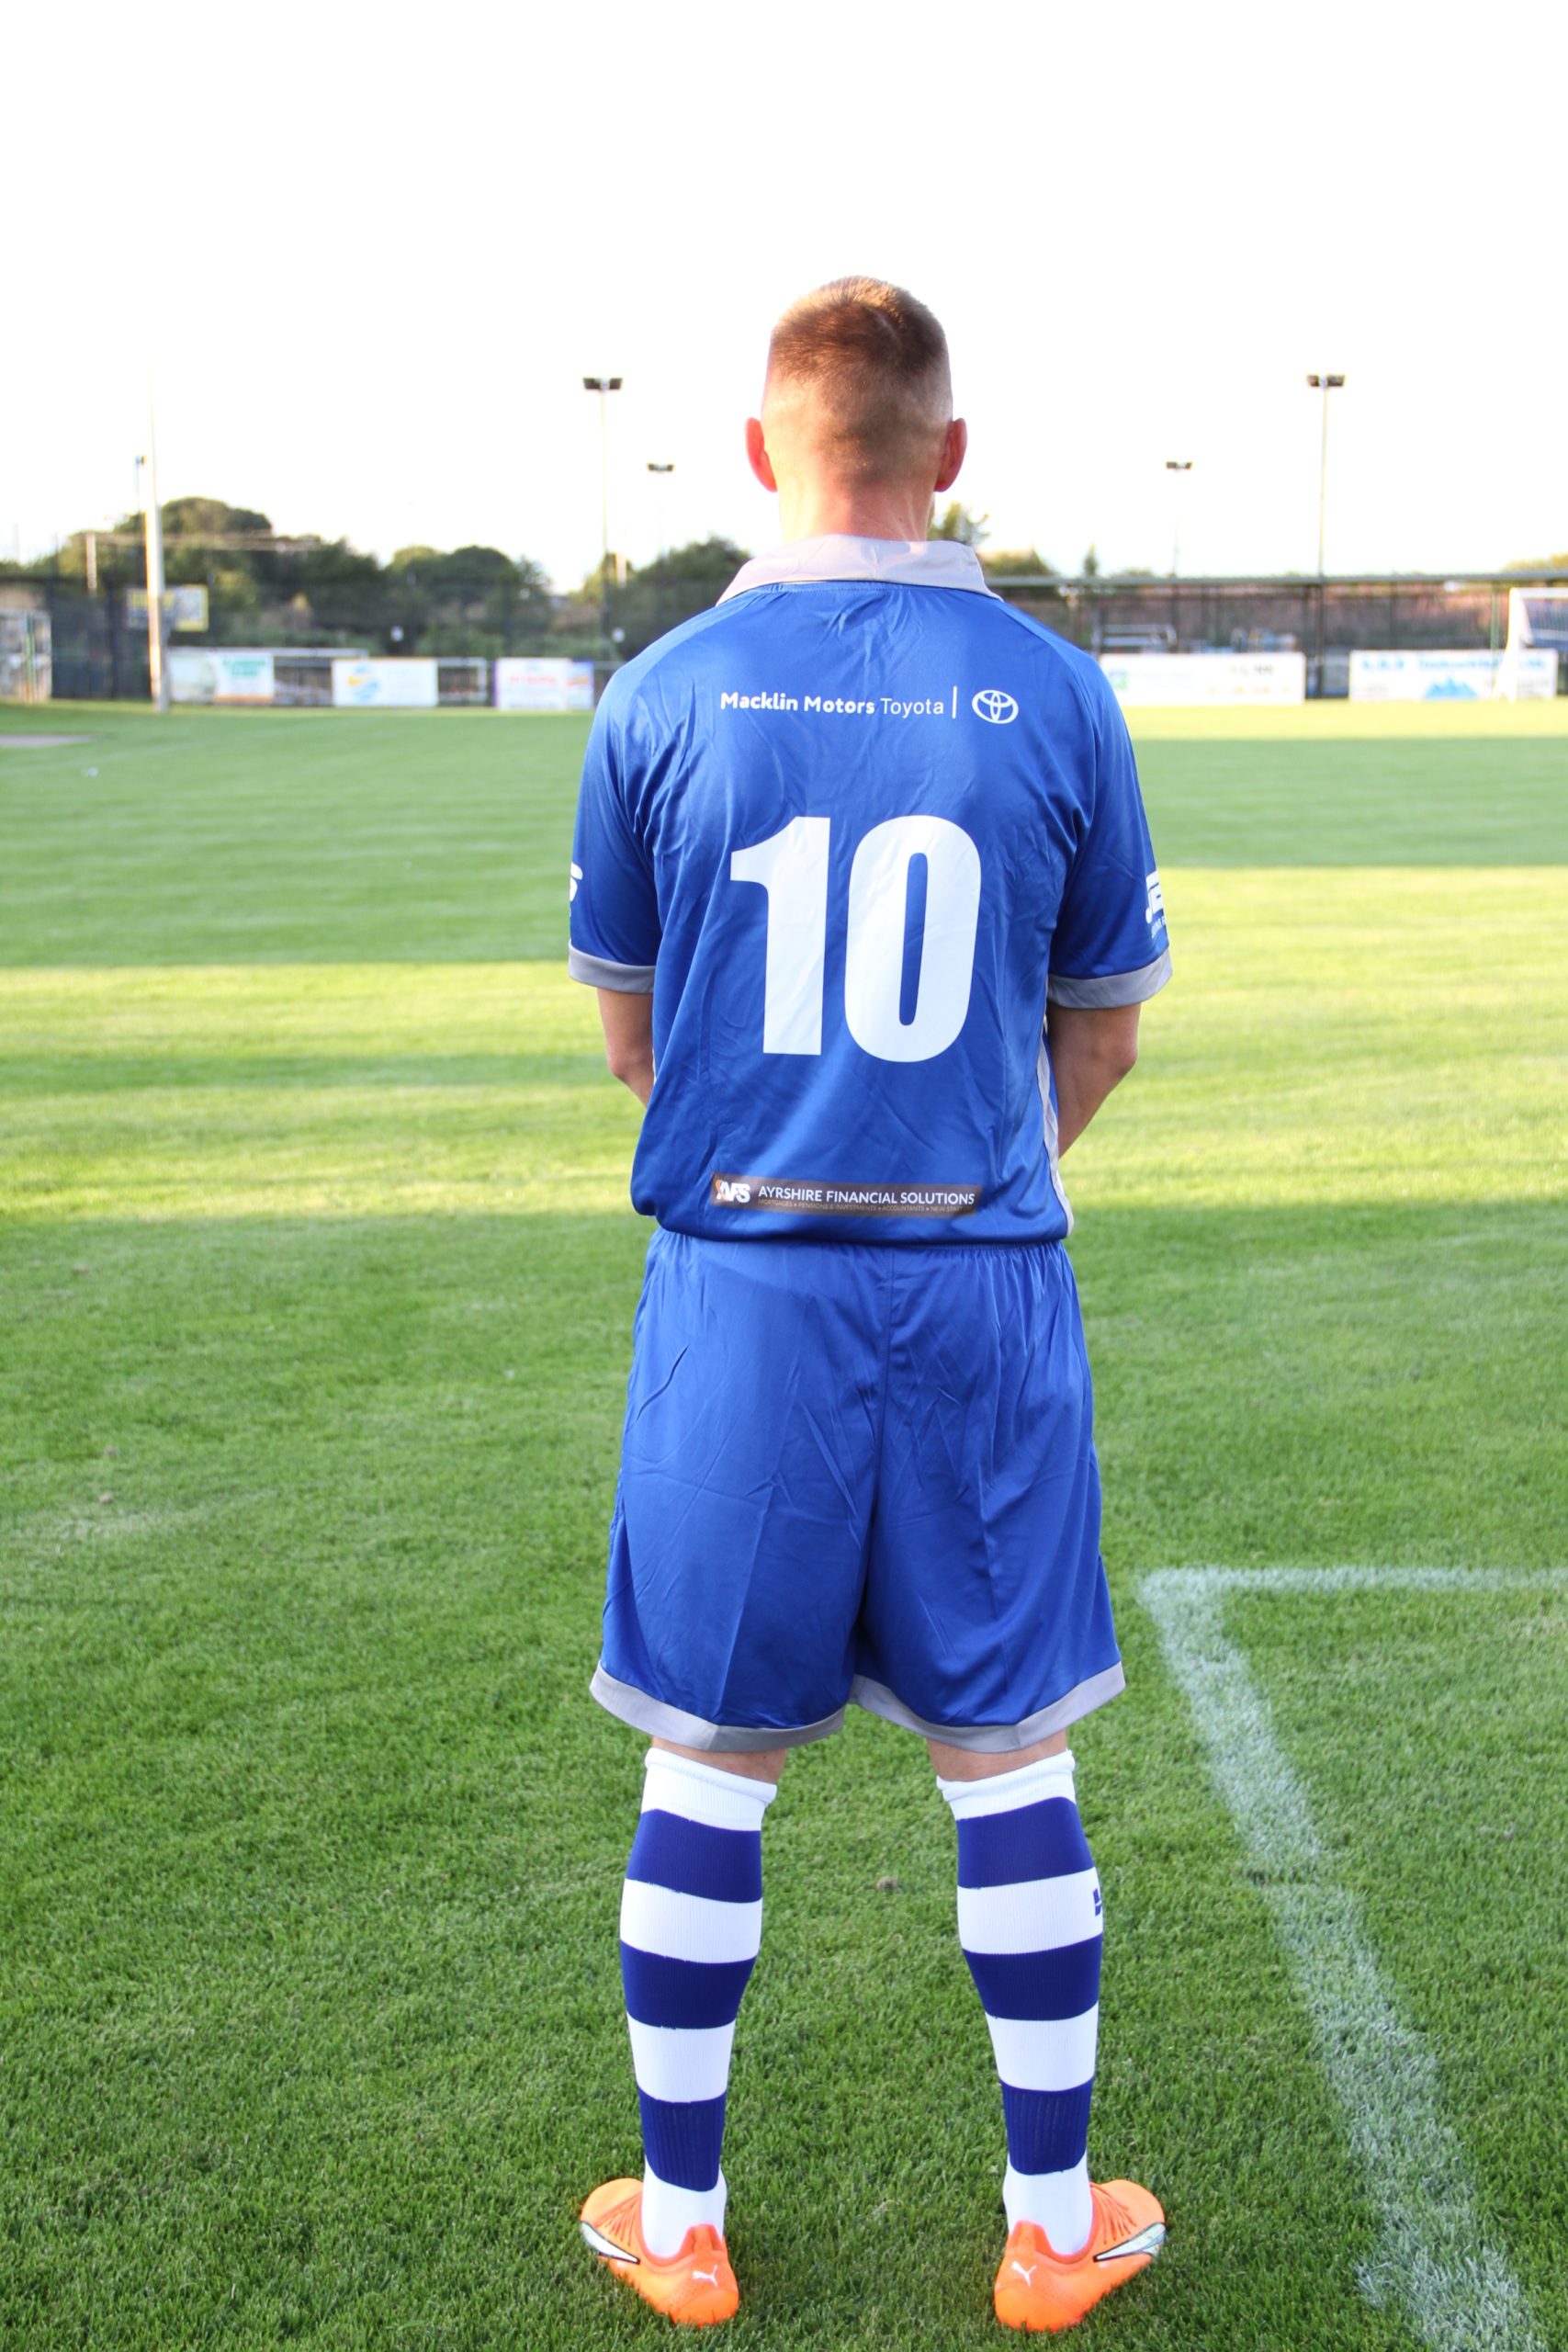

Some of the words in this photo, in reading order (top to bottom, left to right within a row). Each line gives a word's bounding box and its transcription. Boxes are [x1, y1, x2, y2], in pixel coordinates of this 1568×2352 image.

[719, 691, 798, 711] Macklin
[803, 695, 875, 713] Motors
[880, 697, 944, 718] Toyota
[729, 814, 982, 1063] 10
[758, 1185, 823, 1202] AYRSHIRE
[826, 1190, 898, 1204] FINANCIAL
[899, 1192, 976, 1205] SOLUTIONS
